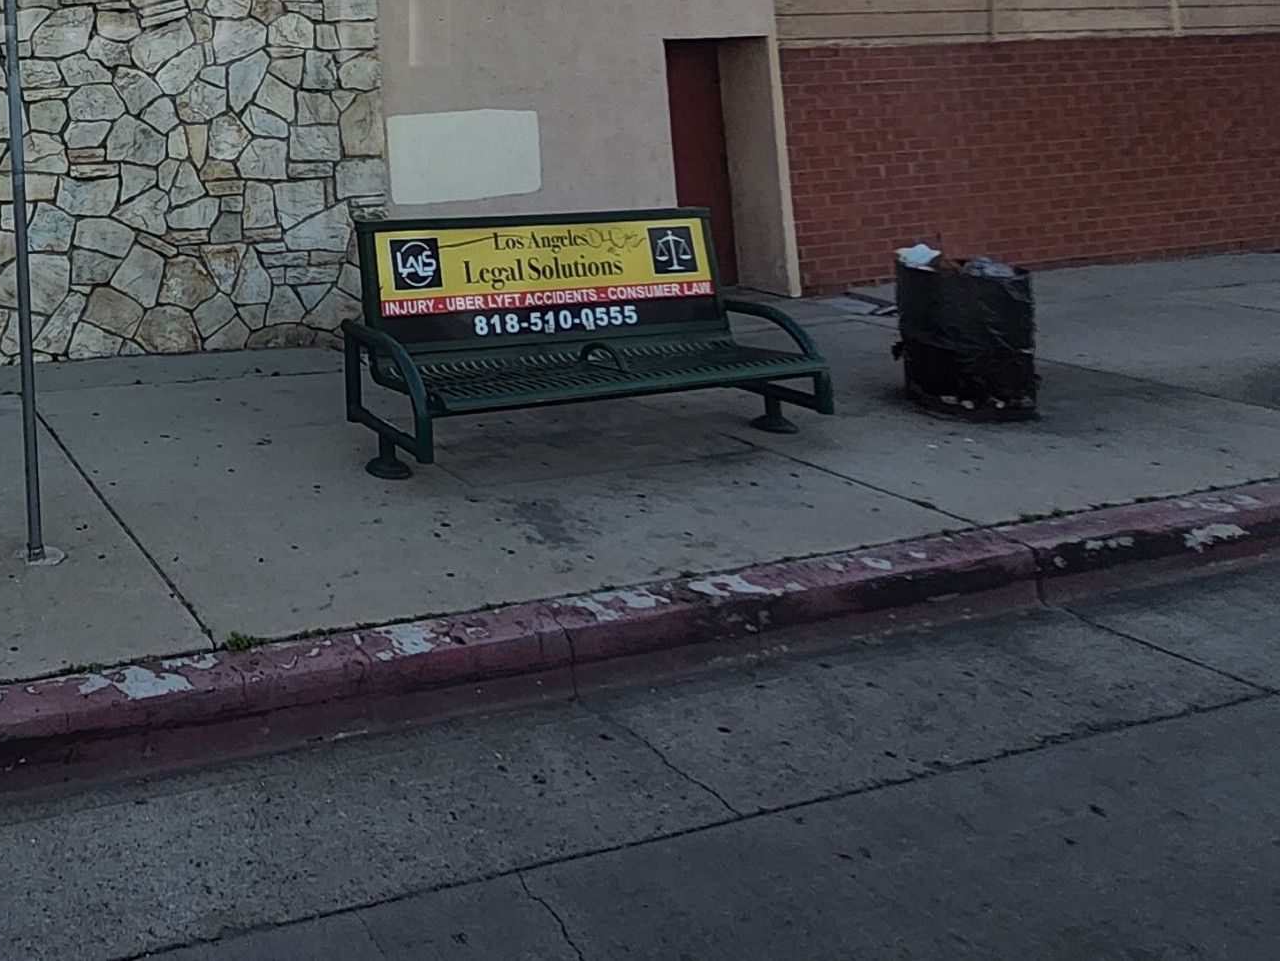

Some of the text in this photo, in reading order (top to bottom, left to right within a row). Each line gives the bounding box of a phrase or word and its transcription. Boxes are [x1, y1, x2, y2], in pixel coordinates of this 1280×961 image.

[493, 232, 525, 251] Los
[528, 230, 589, 254] Angeles
[463, 254, 624, 291] Legal Solutions
[384, 298, 435, 316] INJURY
[446, 295, 486, 312] UBER
[488, 293, 522, 309] LYFT
[524, 288, 598, 307] ACCIDENTS
[607, 284, 682, 301] CONSUMER
[683, 281, 713, 296] LAW
[473, 304, 639, 336] 818-510-0555
